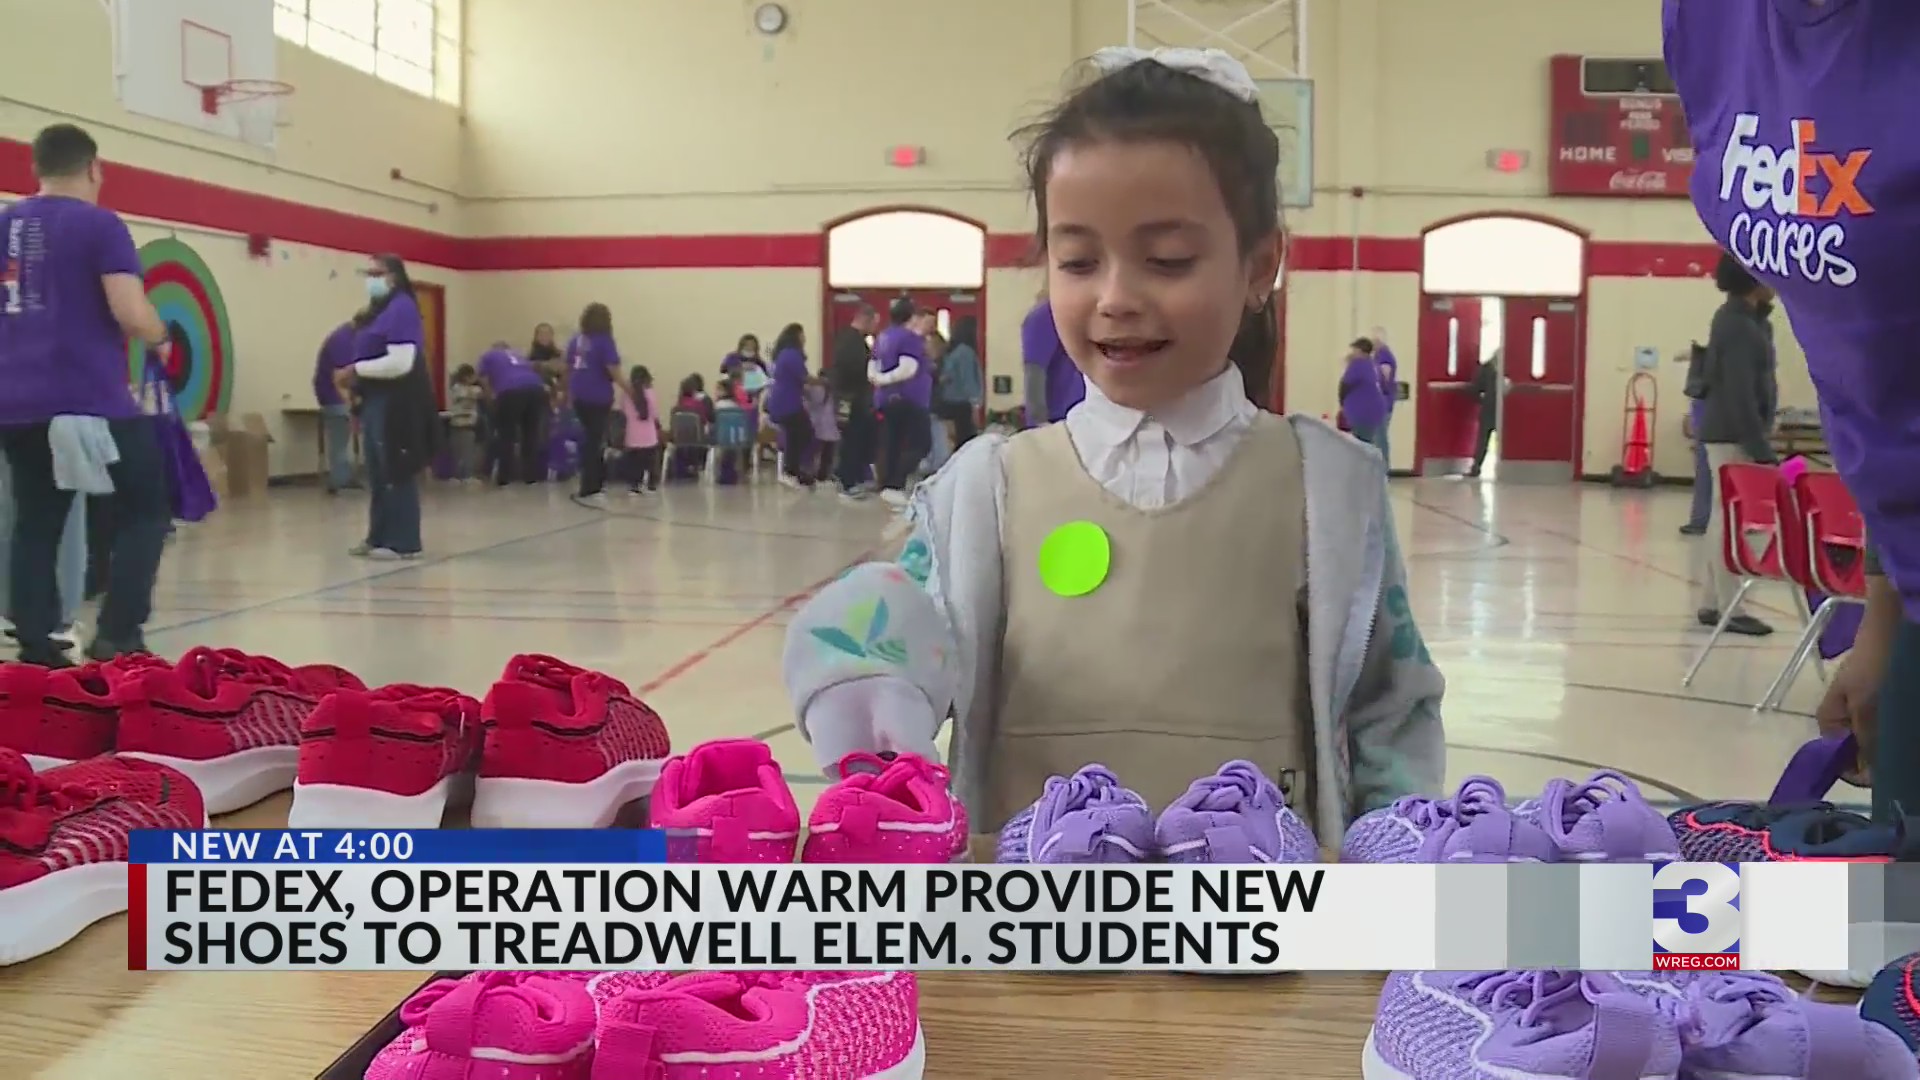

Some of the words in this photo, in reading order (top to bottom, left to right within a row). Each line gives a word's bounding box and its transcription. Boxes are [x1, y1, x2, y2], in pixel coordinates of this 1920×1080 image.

[1560, 146, 1617, 162] HOME
[1719, 112, 1875, 217] FedEx
[1729, 212, 1857, 286] cares
